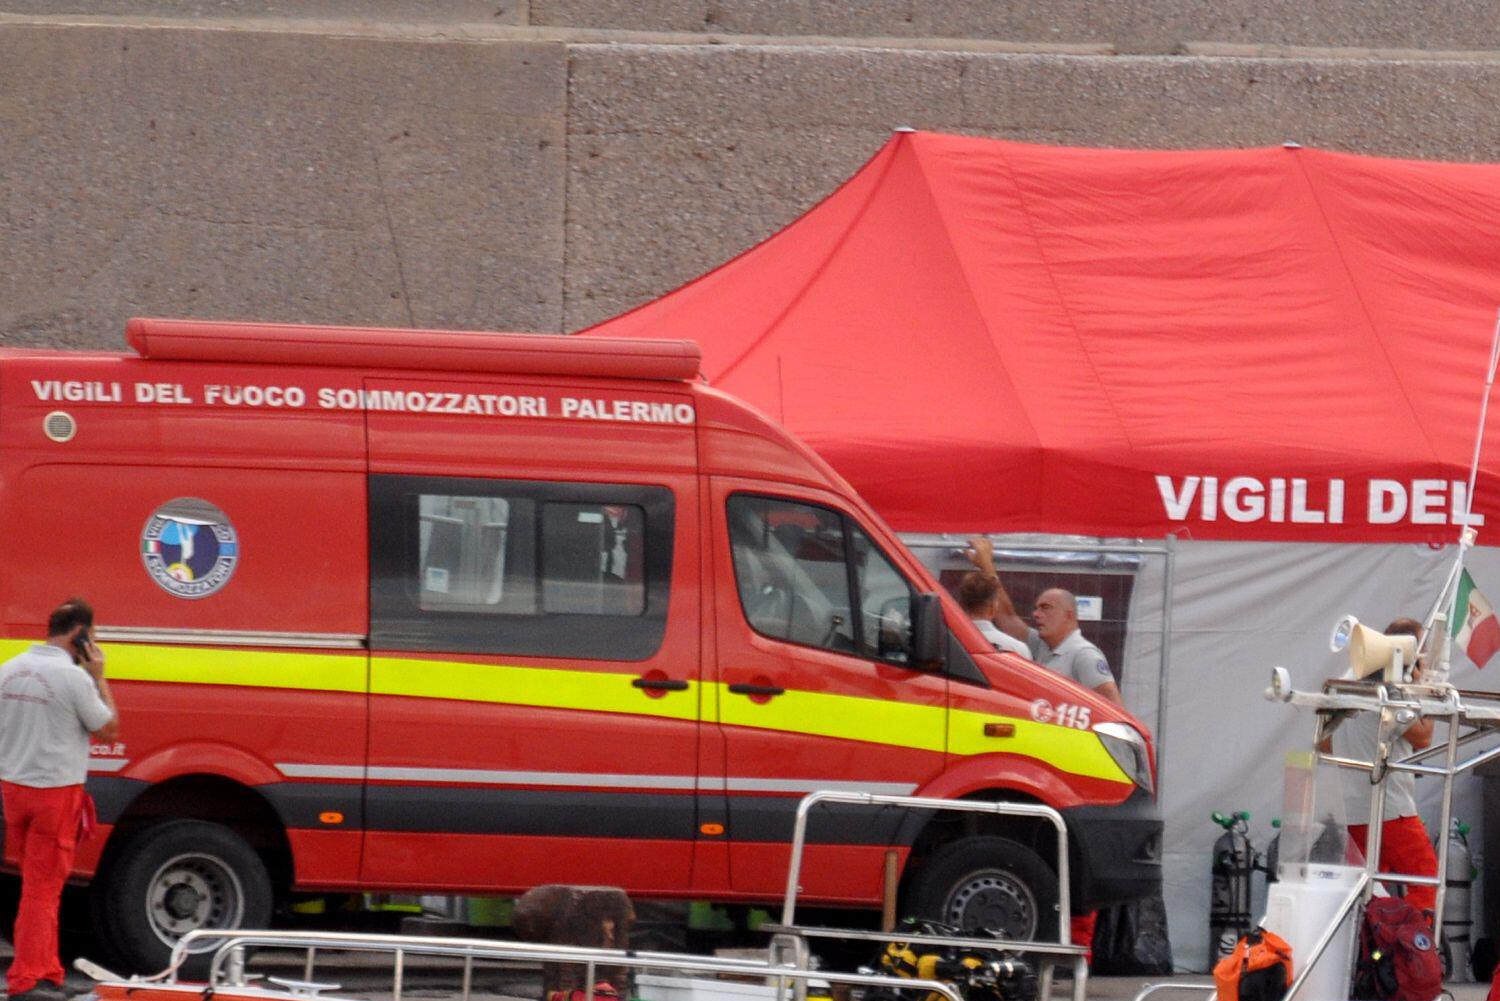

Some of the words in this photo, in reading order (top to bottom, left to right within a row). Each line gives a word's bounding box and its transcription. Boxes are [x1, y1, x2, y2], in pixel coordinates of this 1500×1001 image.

[31, 380, 122, 402] VIGILI
[135, 382, 193, 404] DEL
[204, 385, 306, 407] FUOCO
[318, 388, 547, 417] SOMMOZZATORI
[561, 397, 695, 424] PALERMO
[1155, 475, 1344, 524] VIGILI
[1368, 479, 1485, 526] DEL
[1056, 703, 1091, 730] 115
